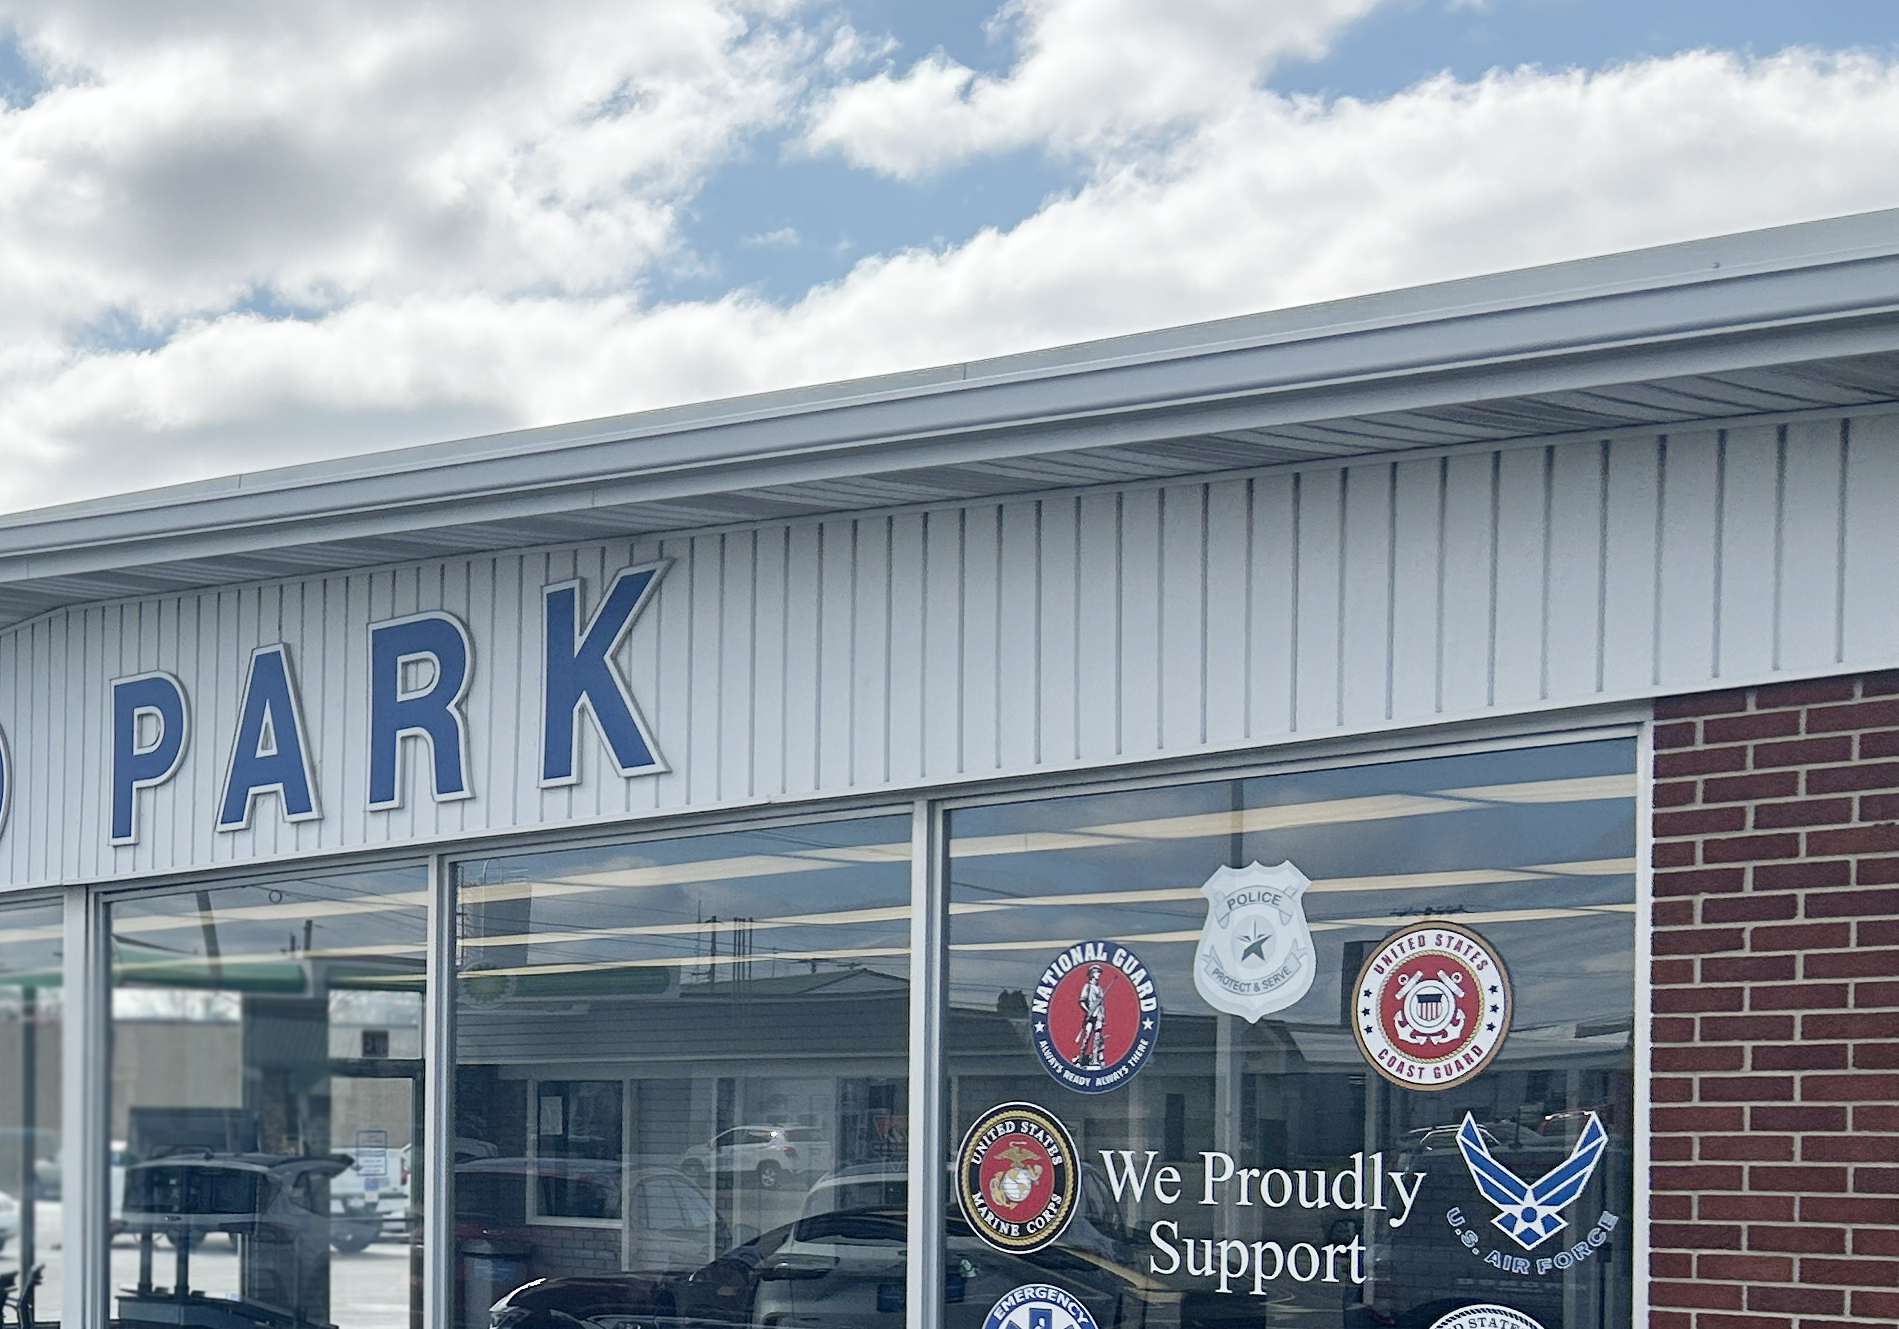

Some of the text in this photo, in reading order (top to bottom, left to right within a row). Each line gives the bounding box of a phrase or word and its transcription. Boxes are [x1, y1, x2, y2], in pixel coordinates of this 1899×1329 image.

[110, 562, 674, 846] PARK
[1227, 891, 1283, 910] POLICE
[1373, 933, 1489, 976] UNITED STATES
[1032, 942, 1157, 1014] NATIONAL GUARD
[1211, 967, 1292, 992] PROTECT & SERVE
[1039, 1038, 1149, 1087] ALWAYS READY ALWAYS THERE
[1377, 1045, 1483, 1080] COAST GUARD
[971, 1121, 1063, 1166] UNITED STATES
[1098, 1149, 1427, 1228] We Proudly
[972, 1191, 1063, 1236] MARINE CORPS
[1149, 1220, 1367, 1296] Support
[1446, 1206, 1620, 1276] U.S. AIR FORCE
[993, 1288, 1090, 1324] EMERGENCY
